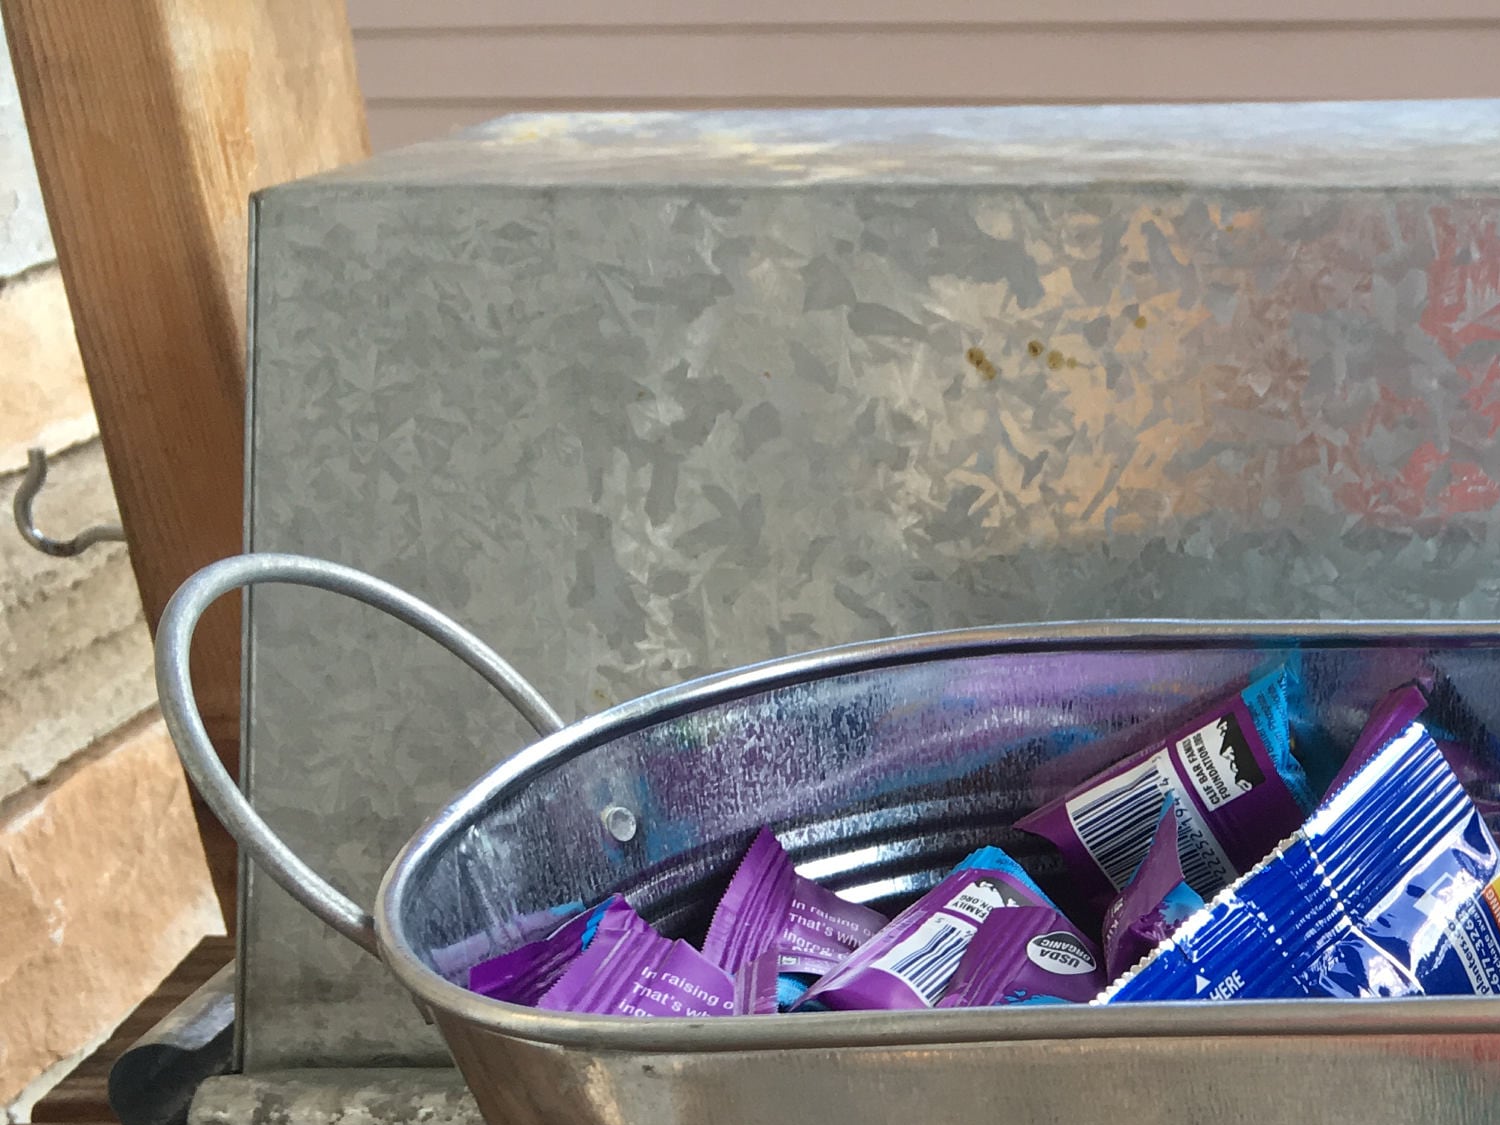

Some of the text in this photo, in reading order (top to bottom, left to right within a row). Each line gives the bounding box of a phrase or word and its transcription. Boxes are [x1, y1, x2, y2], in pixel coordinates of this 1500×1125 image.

[1192, 763, 1208, 784] BAR
[1203, 785, 1220, 805] CLIF
[790, 899, 806, 911] In
[810, 906, 860, 931] raising
[952, 900, 987, 919] FAMILY
[789, 912, 834, 937] That's
[1039, 948, 1080, 968] USDA
[1040, 939, 1091, 962] ORGANIC
[1446, 919, 1490, 994] planters.co
[632, 982, 683, 1012] That's
[641, 966, 658, 980] In
[661, 972, 720, 1007] raising
[1209, 969, 1245, 1000] HERE
